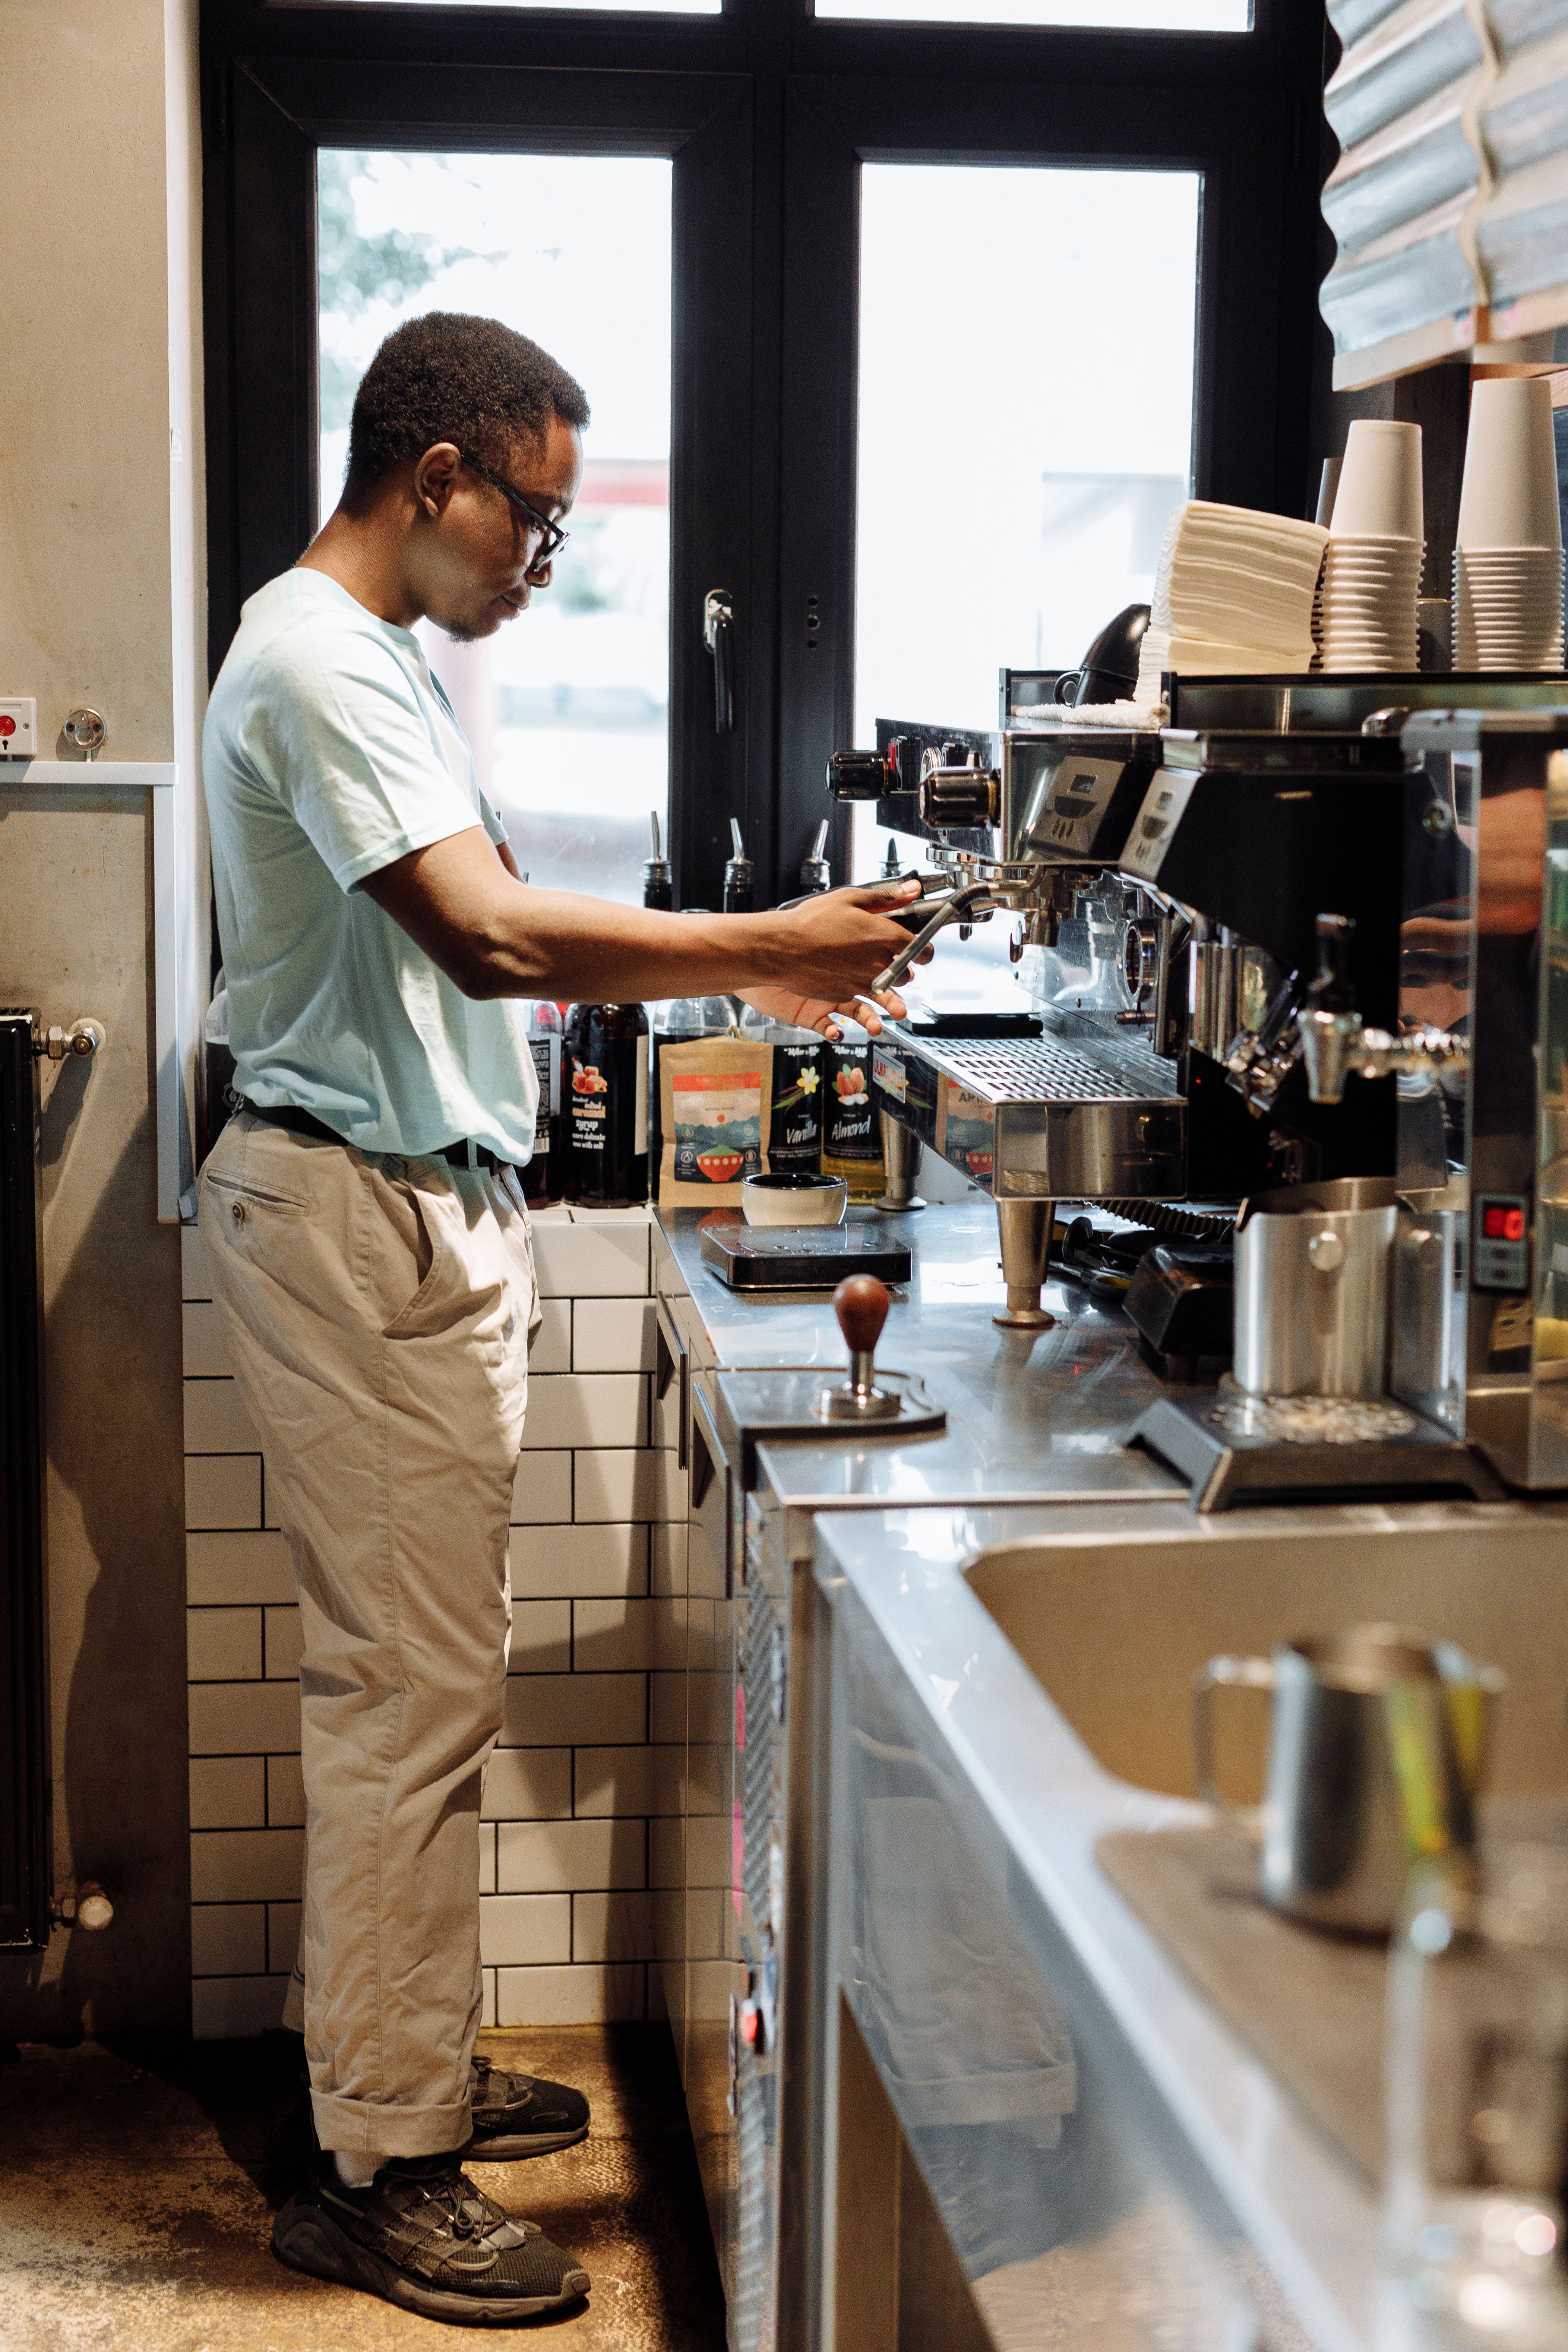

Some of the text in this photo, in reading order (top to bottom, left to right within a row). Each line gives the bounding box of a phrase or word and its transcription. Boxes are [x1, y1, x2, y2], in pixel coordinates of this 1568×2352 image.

[576, 1119, 598, 1131] syrup
[787, 1120, 817, 1144] Vanilla
[831, 1115, 871, 1141] Almond
